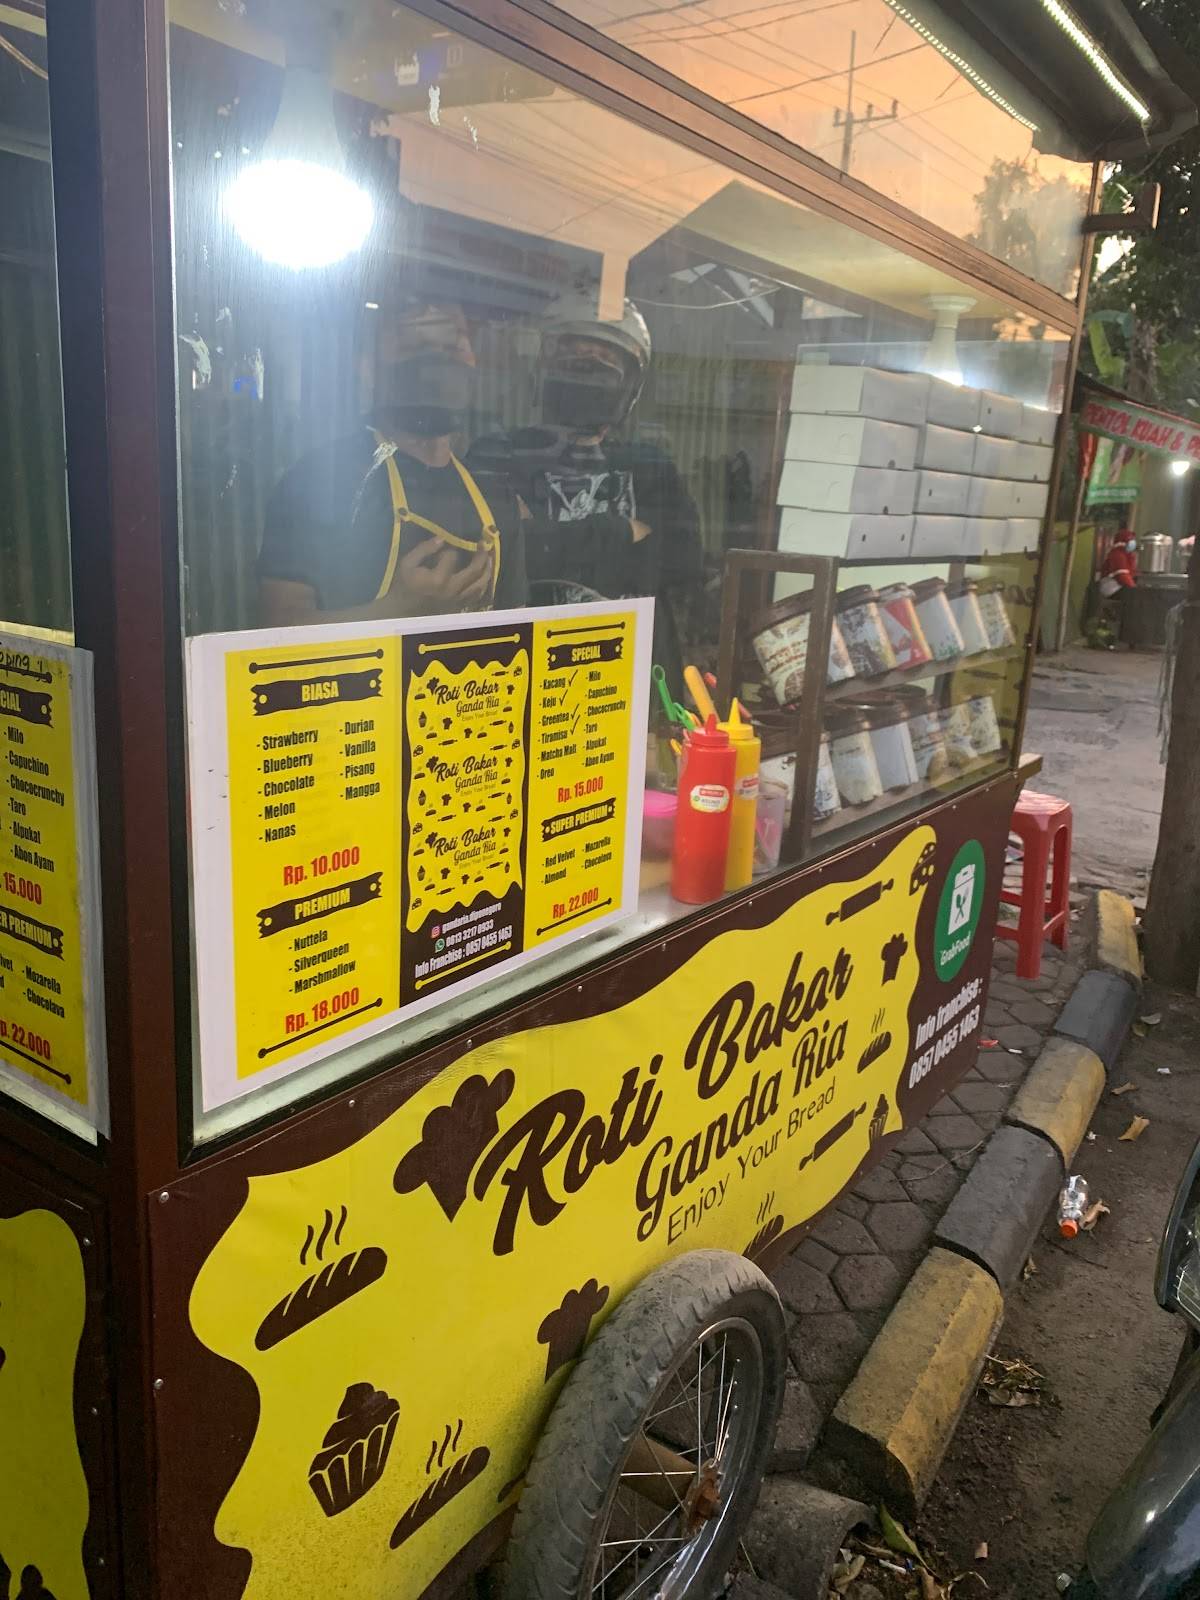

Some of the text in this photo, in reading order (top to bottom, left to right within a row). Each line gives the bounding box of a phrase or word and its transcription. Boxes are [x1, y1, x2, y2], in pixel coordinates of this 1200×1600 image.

[571, 644, 601, 662] SPECIAL
[543, 677, 566, 690] Kacang
[588, 670, 601, 682] Milo
[301, 680, 339, 703] BIASA
[434, 679, 499, 706] Roti Bakar
[542, 697, 557, 709] Keju
[587, 684, 618, 700] Capuchino
[456, 698, 484, 717] Ganda
[486, 695, 500, 709] Ria
[587, 699, 627, 717] Chococrunchy
[344, 719, 375, 735] Durian
[541, 712, 570, 727] Greentea
[585, 723, 598, 734] Taro
[8, 725, 24, 744] Milo
[262, 729, 319, 751] Strawberry
[541, 729, 568, 744] Tiramisu
[585, 736, 607, 751] Alpukat
[344, 740, 376, 757] Vanilla
[541, 747, 563, 762] Matcha
[599, 751, 615, 764] Ayam
[9, 750, 49, 776] Capuchino
[263, 752, 314, 774] Blueberry
[344, 762, 375, 779] Pisang
[434, 754, 498, 783] Roti Bakar
[540, 767, 555, 780] Oreo
[10, 774, 65, 807] Chococrunchy
[263, 774, 315, 797] Chocolate
[344, 781, 380, 800] Mangga
[455, 773, 483, 793] Ganda
[484, 769, 498, 782] Ria
[557, 776, 603, 803] Rp. 15.000
[10, 797, 26, 816] Taro
[264, 801, 296, 820] Melon
[550, 804, 608, 835] SUPER PREMIUM
[13, 820, 41, 844] Alpukat
[265, 823, 296, 843] Nanas
[433, 825, 497, 858] Roti Bakar
[14, 844, 54, 872] Abon Ayam
[454, 846, 482, 866] Ganda
[482, 840, 497, 853] Ria
[545, 849, 576, 868] Red Velvet
[283, 846, 360, 887] Rp. 10.000
[544, 868, 567, 885] Almond
[3, 871, 42, 905] 15.000
[294, 887, 351, 920] PREMIUM
[552, 887, 599, 919] Rp. 22.000
[8, 913, 52, 949] PREMIUM
[294, 929, 328, 951] Nuttela
[294, 942, 350, 973] Silverqueen
[939, 930, 972, 967] GrabFood
[414, 959, 430, 978] Info
[429, 947, 464, 974] Franchise
[25, 965, 61, 994] Mozarella
[294, 960, 356, 994] Marshmallow
[26, 987, 65, 1018] Chocolava
[284, 987, 360, 1034] Rp. 18.000
[12, 1023, 51, 1061] 22.000
[914, 1013, 937, 1050] Info
[908, 1003, 981, 1089] 0857 0455 1463
[474, 946, 854, 1256] Roti Bakar
[635, 1018, 849, 1242] Ganda Ria
[667, 1075, 837, 1246] Enjoy Your Bread
